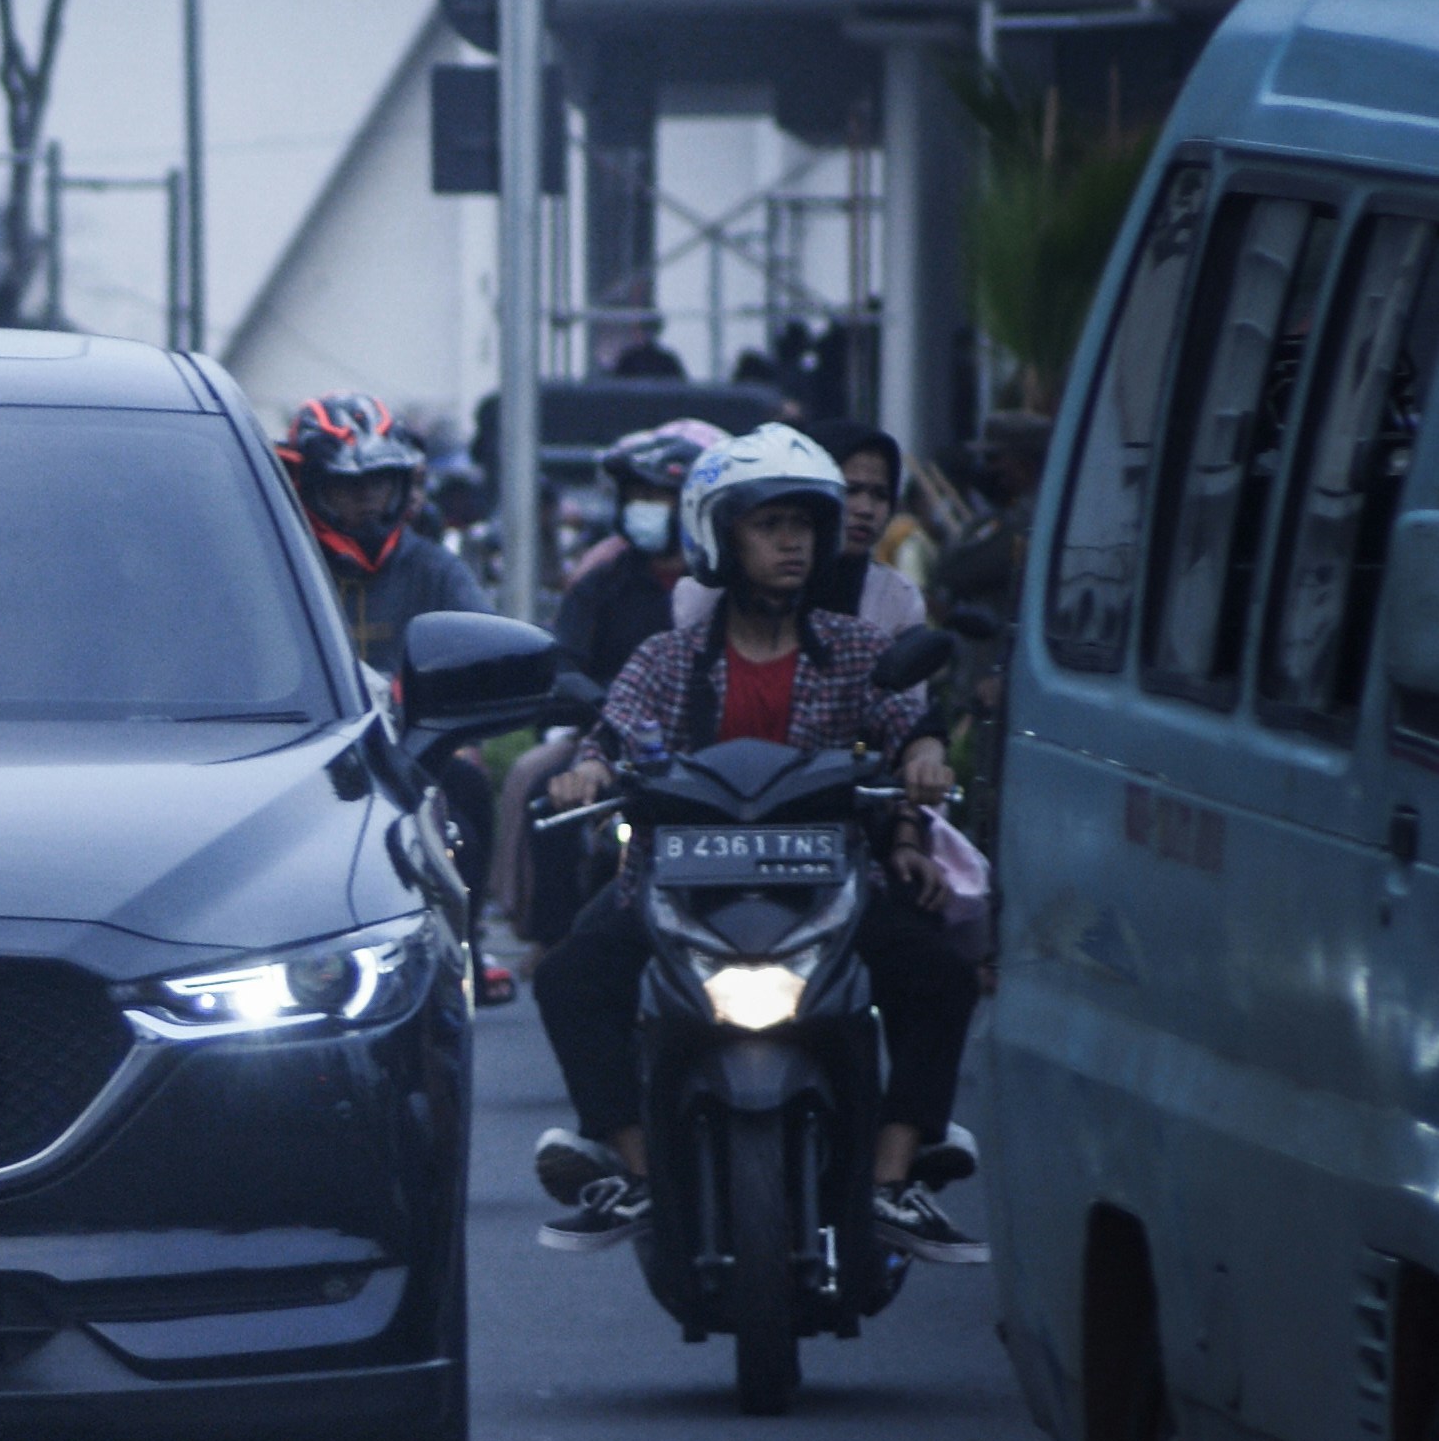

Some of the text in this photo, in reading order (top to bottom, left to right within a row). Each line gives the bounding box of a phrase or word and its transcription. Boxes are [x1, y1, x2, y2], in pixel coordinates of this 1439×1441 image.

[666, 835, 833, 858] B 4361 TNS
